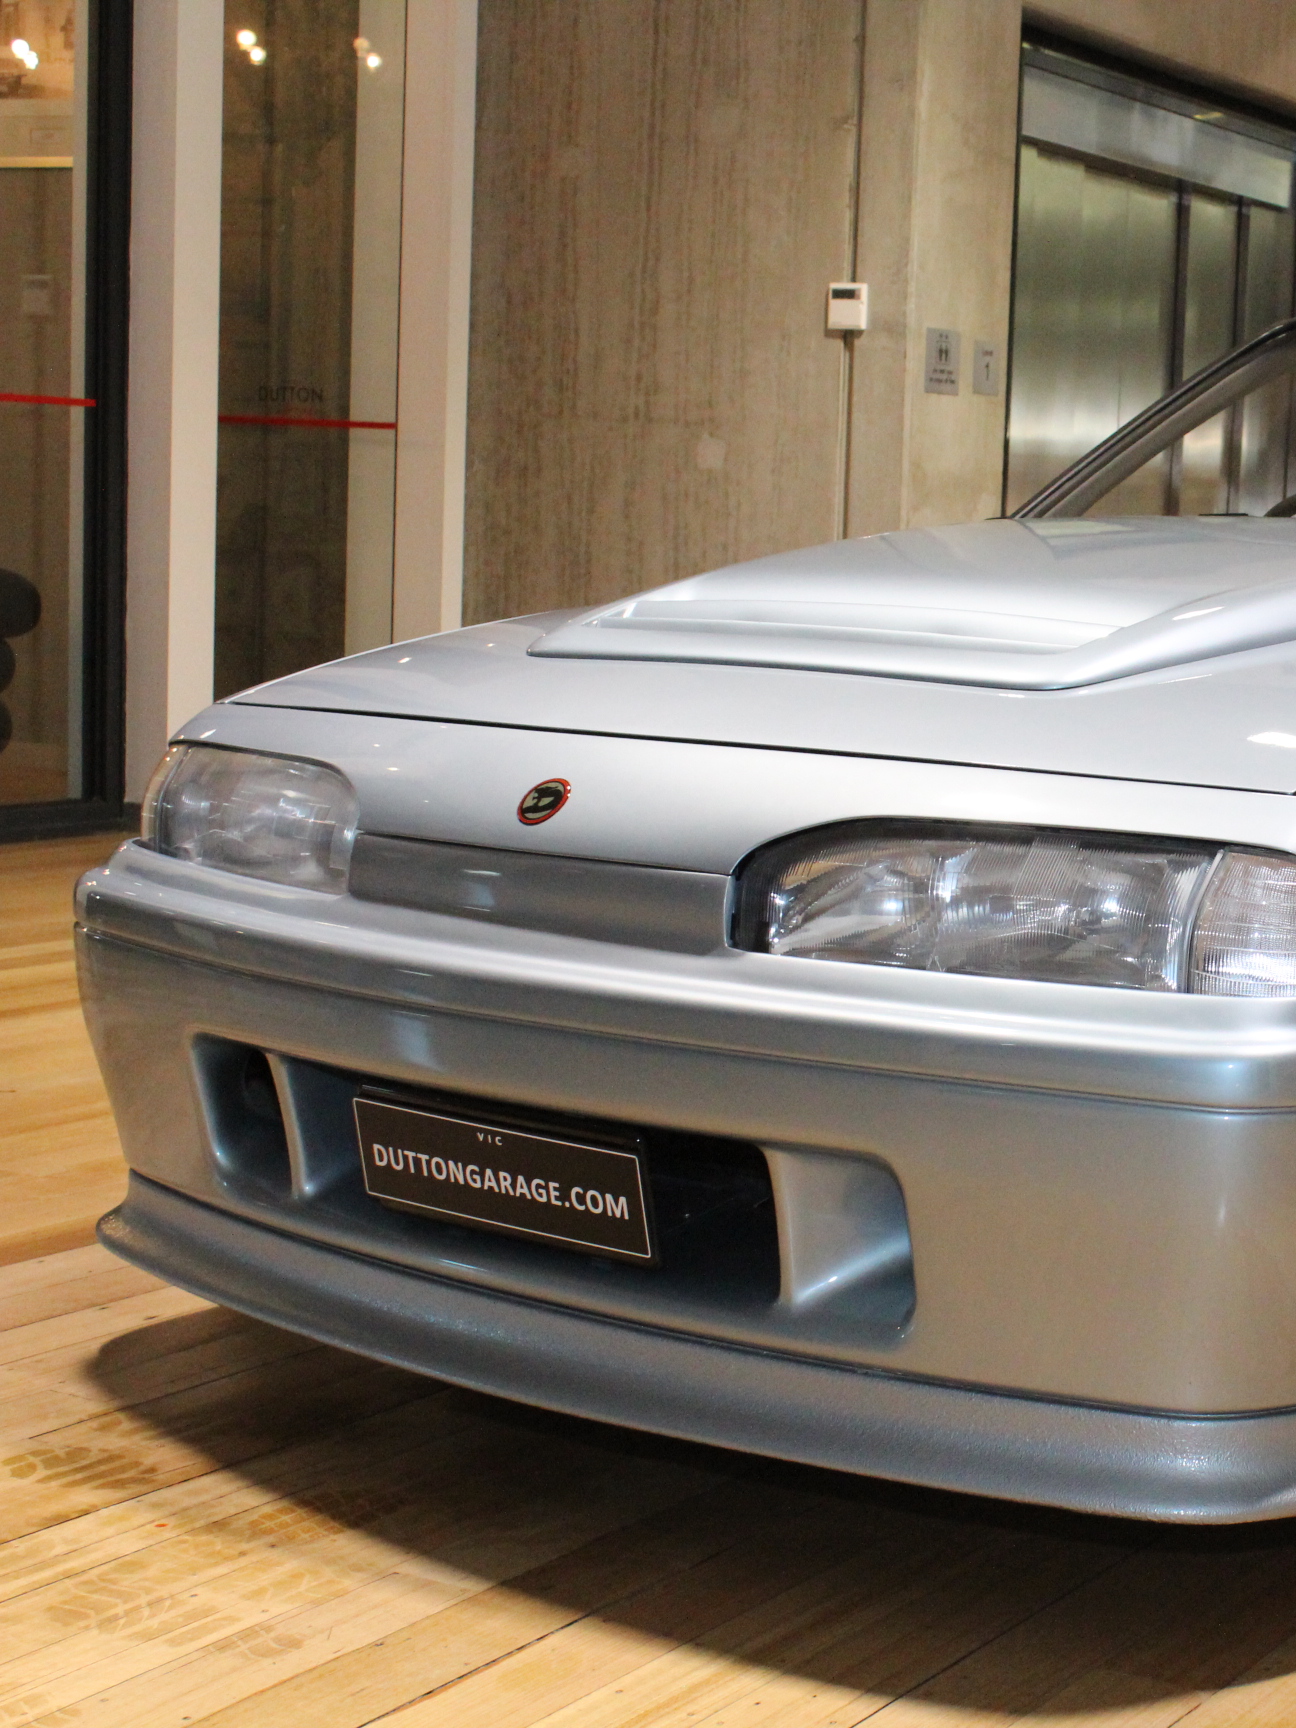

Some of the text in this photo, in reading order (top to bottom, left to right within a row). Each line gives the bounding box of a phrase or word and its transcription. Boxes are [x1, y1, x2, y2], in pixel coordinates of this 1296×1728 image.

[259, 386, 323, 402] DUTTON
[476, 1131, 503, 1146] VIC
[372, 1143, 630, 1220] DUTTONGARAGE.COM
